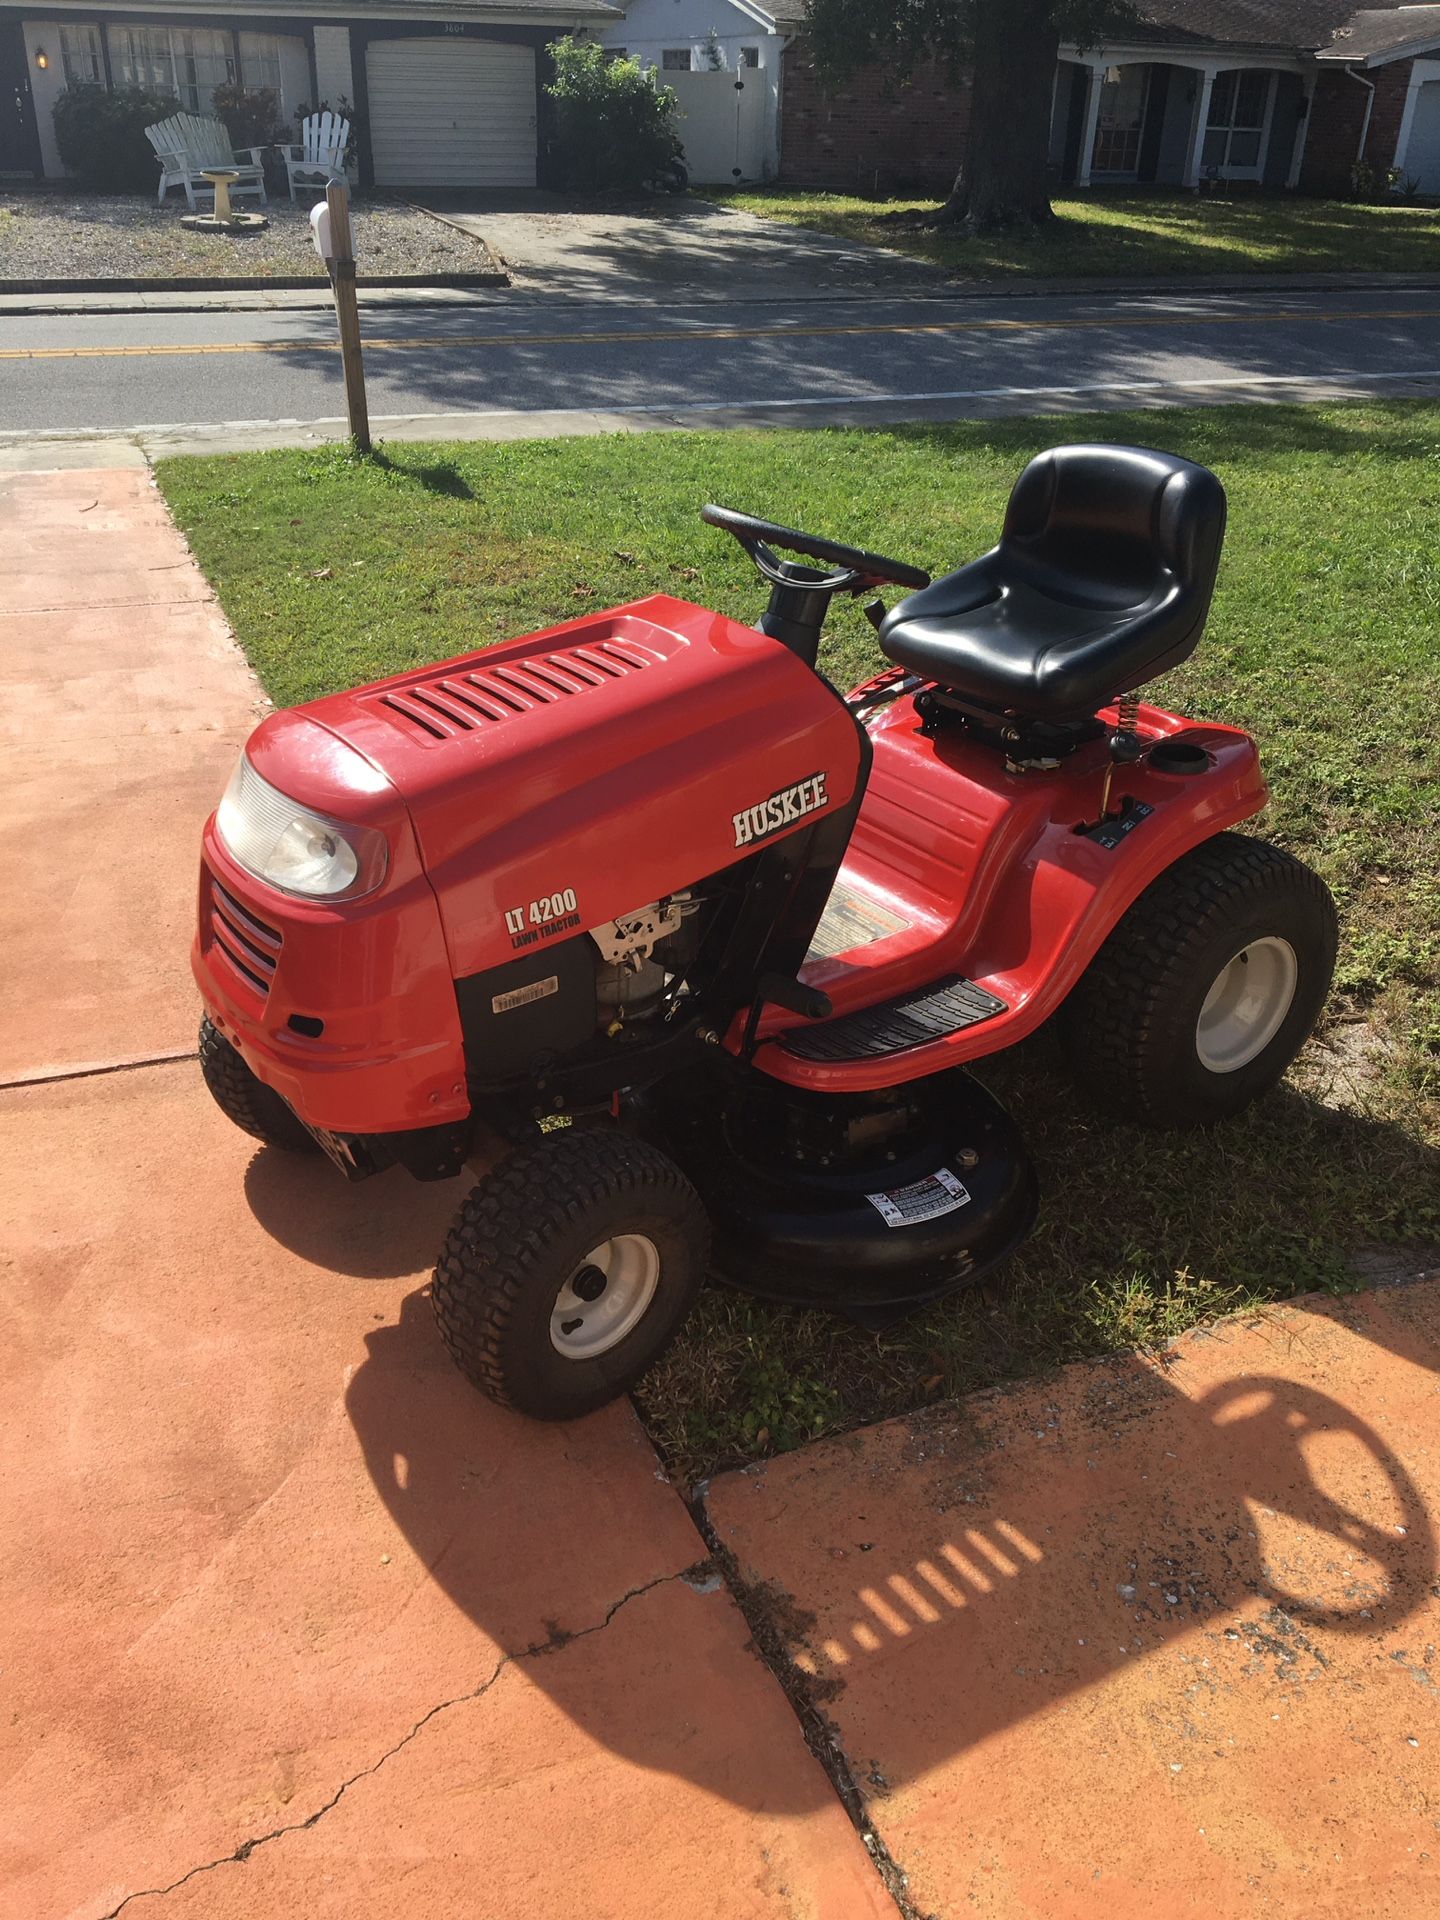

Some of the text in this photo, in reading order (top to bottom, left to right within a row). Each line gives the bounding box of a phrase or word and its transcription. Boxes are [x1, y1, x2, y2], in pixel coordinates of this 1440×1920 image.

[732, 772, 828, 847] HUSKEE
[504, 888, 577, 935] LT 4200
[511, 913, 582, 949] LAWN TRACTOR
